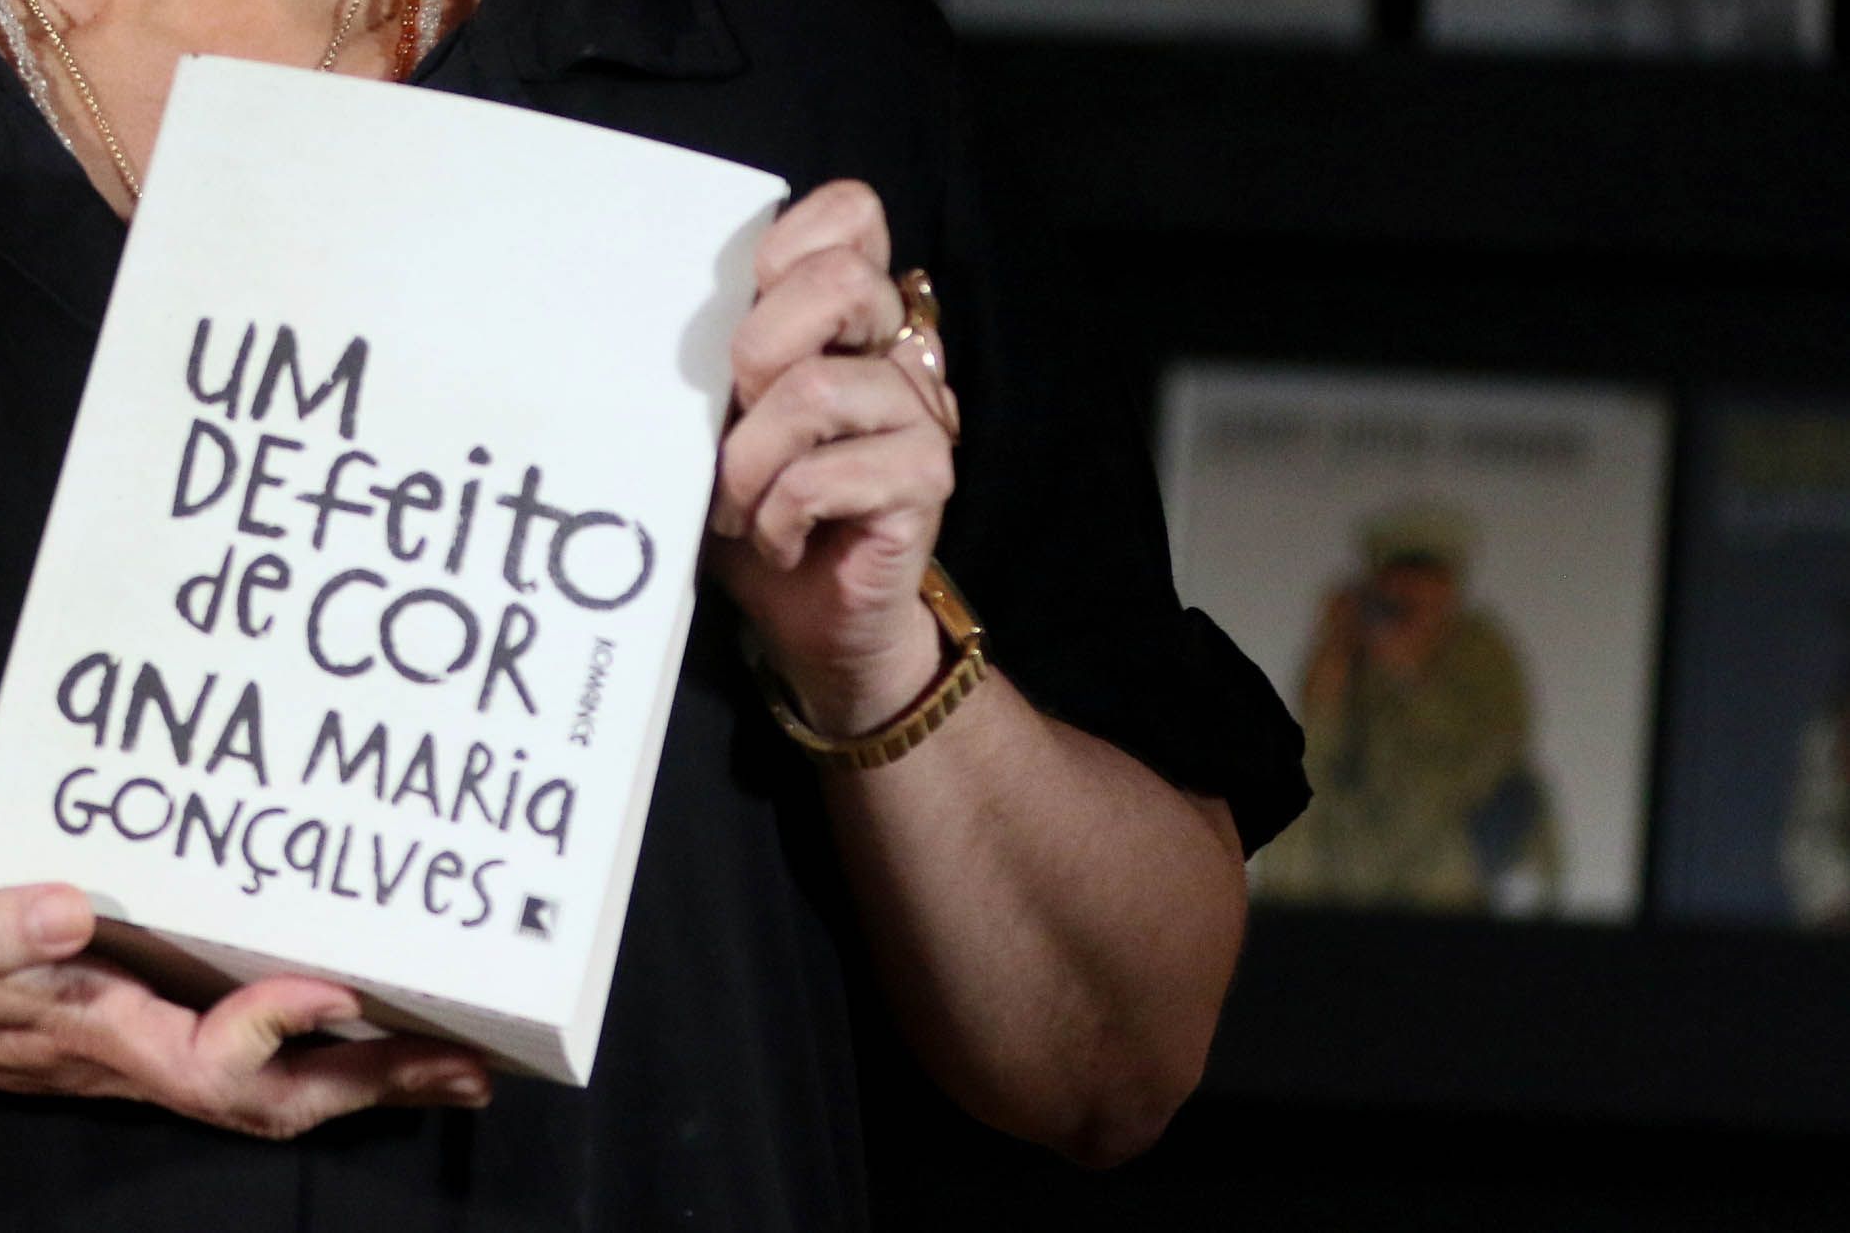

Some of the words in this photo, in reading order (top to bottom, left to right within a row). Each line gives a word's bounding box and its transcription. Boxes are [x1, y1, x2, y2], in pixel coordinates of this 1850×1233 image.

[185, 317, 370, 441] UM
[174, 545, 293, 640] de
[305, 568, 540, 716] COR
